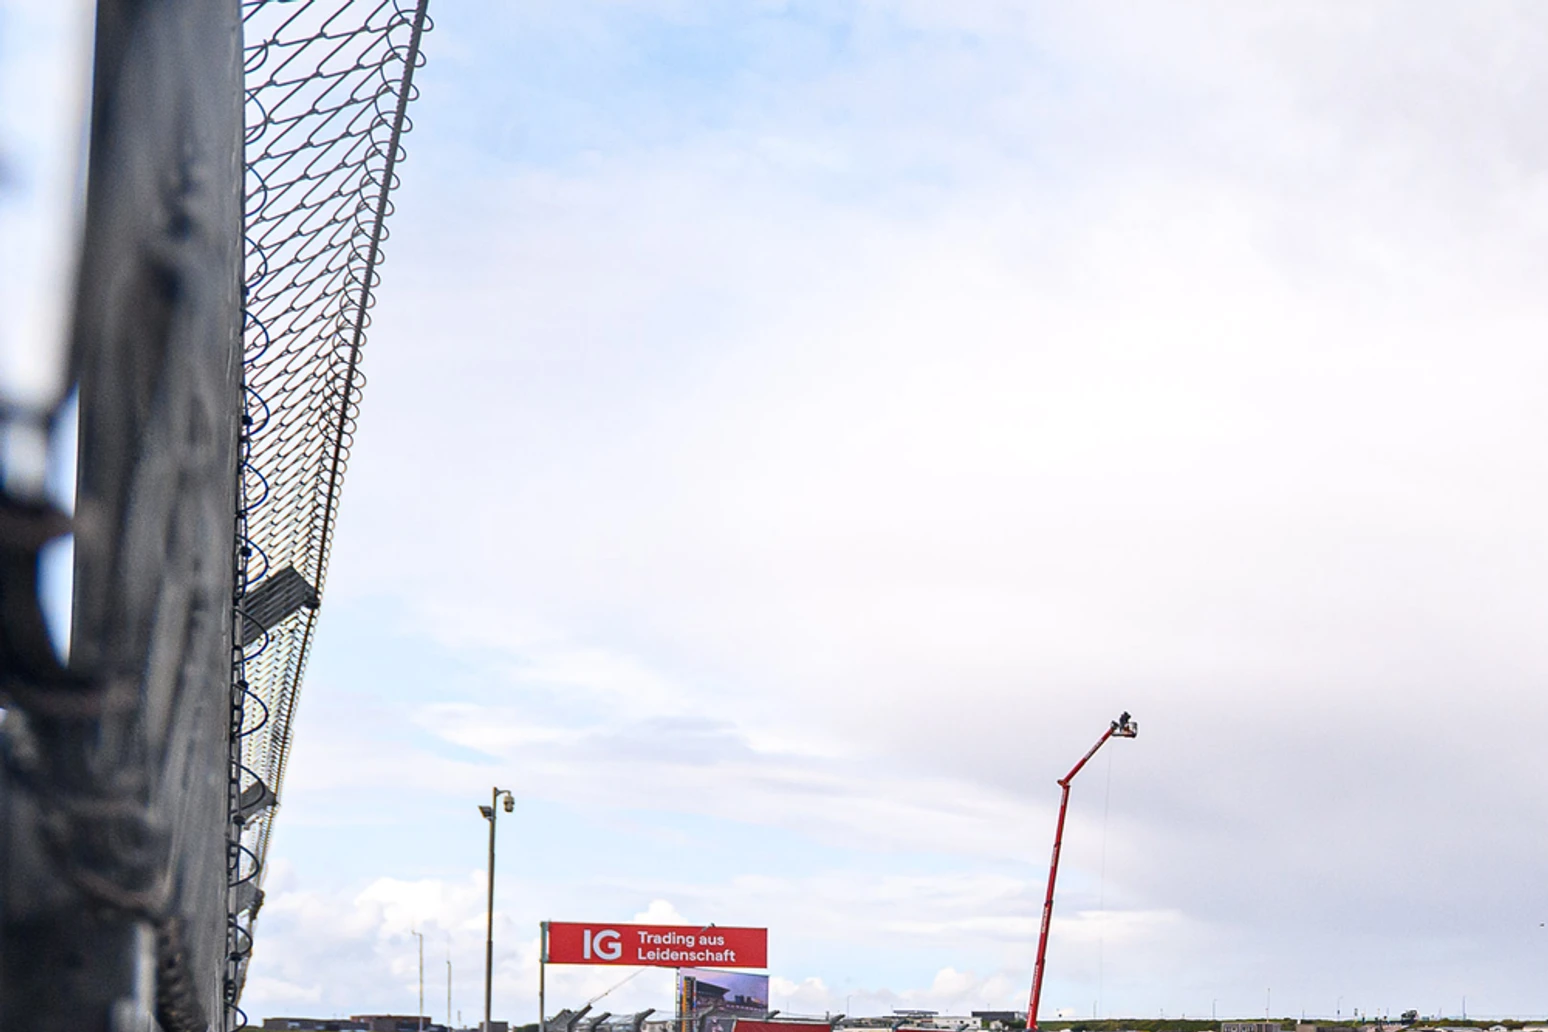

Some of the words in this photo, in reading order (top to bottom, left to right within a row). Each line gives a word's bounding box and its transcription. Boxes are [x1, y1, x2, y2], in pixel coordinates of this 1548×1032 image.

[583, 929, 622, 961] IG
[637, 931, 695, 947] Trading
[698, 935, 725, 946] aus
[637, 948, 736, 962] Leidenschaft
